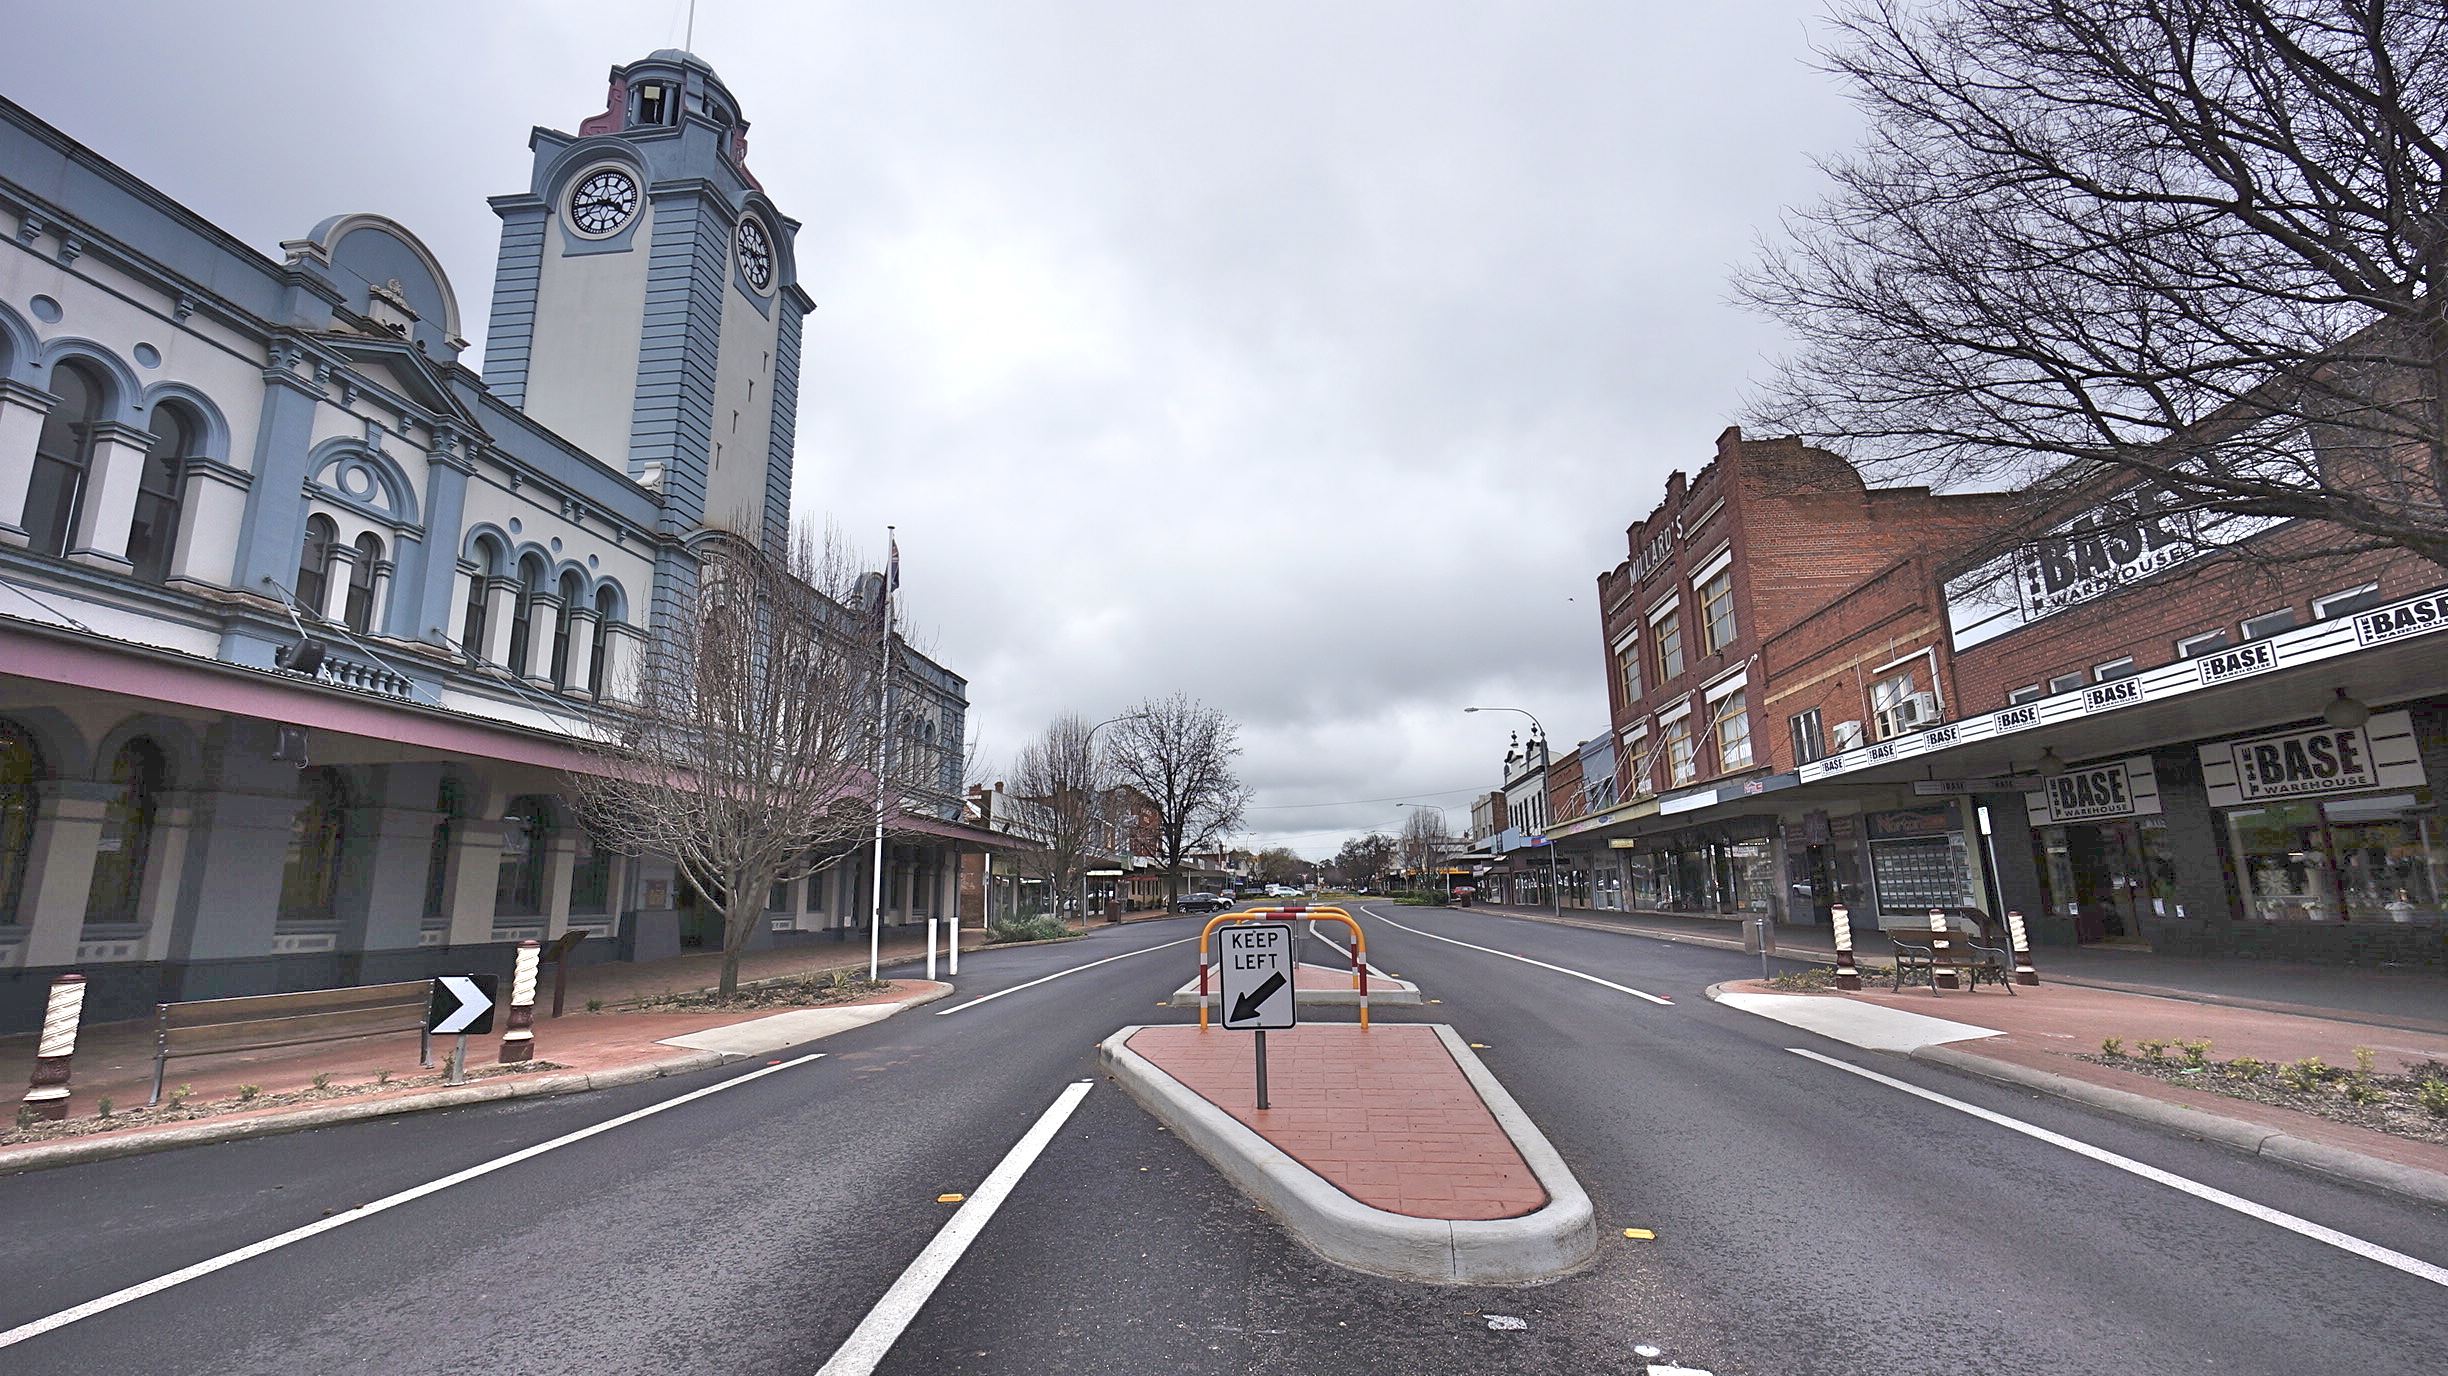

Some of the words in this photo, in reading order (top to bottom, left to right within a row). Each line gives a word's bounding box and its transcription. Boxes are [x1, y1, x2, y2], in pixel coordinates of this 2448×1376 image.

[1629, 515, 1683, 587] MILLARD'S
[2038, 487, 2178, 595] BASE
[2371, 596, 2448, 634] BASE
[2361, 617, 2374, 642] THE
[2376, 618, 2448, 639] WAREHOUS
[2210, 646, 2269, 675] BASE
[2214, 662, 2271, 679] WAREHOUSE
[2203, 661, 2212, 681] THE
[2092, 681, 2137, 705] BASE
[2002, 707, 2036, 727] BASE
[1930, 728, 1957, 745] BASE
[1872, 744, 1894, 759] BASE
[2255, 731, 2363, 784] BASE
[1824, 758, 1843, 772] BASE
[2241, 748, 2259, 796] THE
[2058, 769, 2125, 809] BASE
[2264, 776, 2367, 794] WAREHOUSE
[2064, 804, 2128, 817] WAREHOUSE
[1232, 932, 1278, 949] KEEP
[1235, 954, 1277, 970] LEFT
